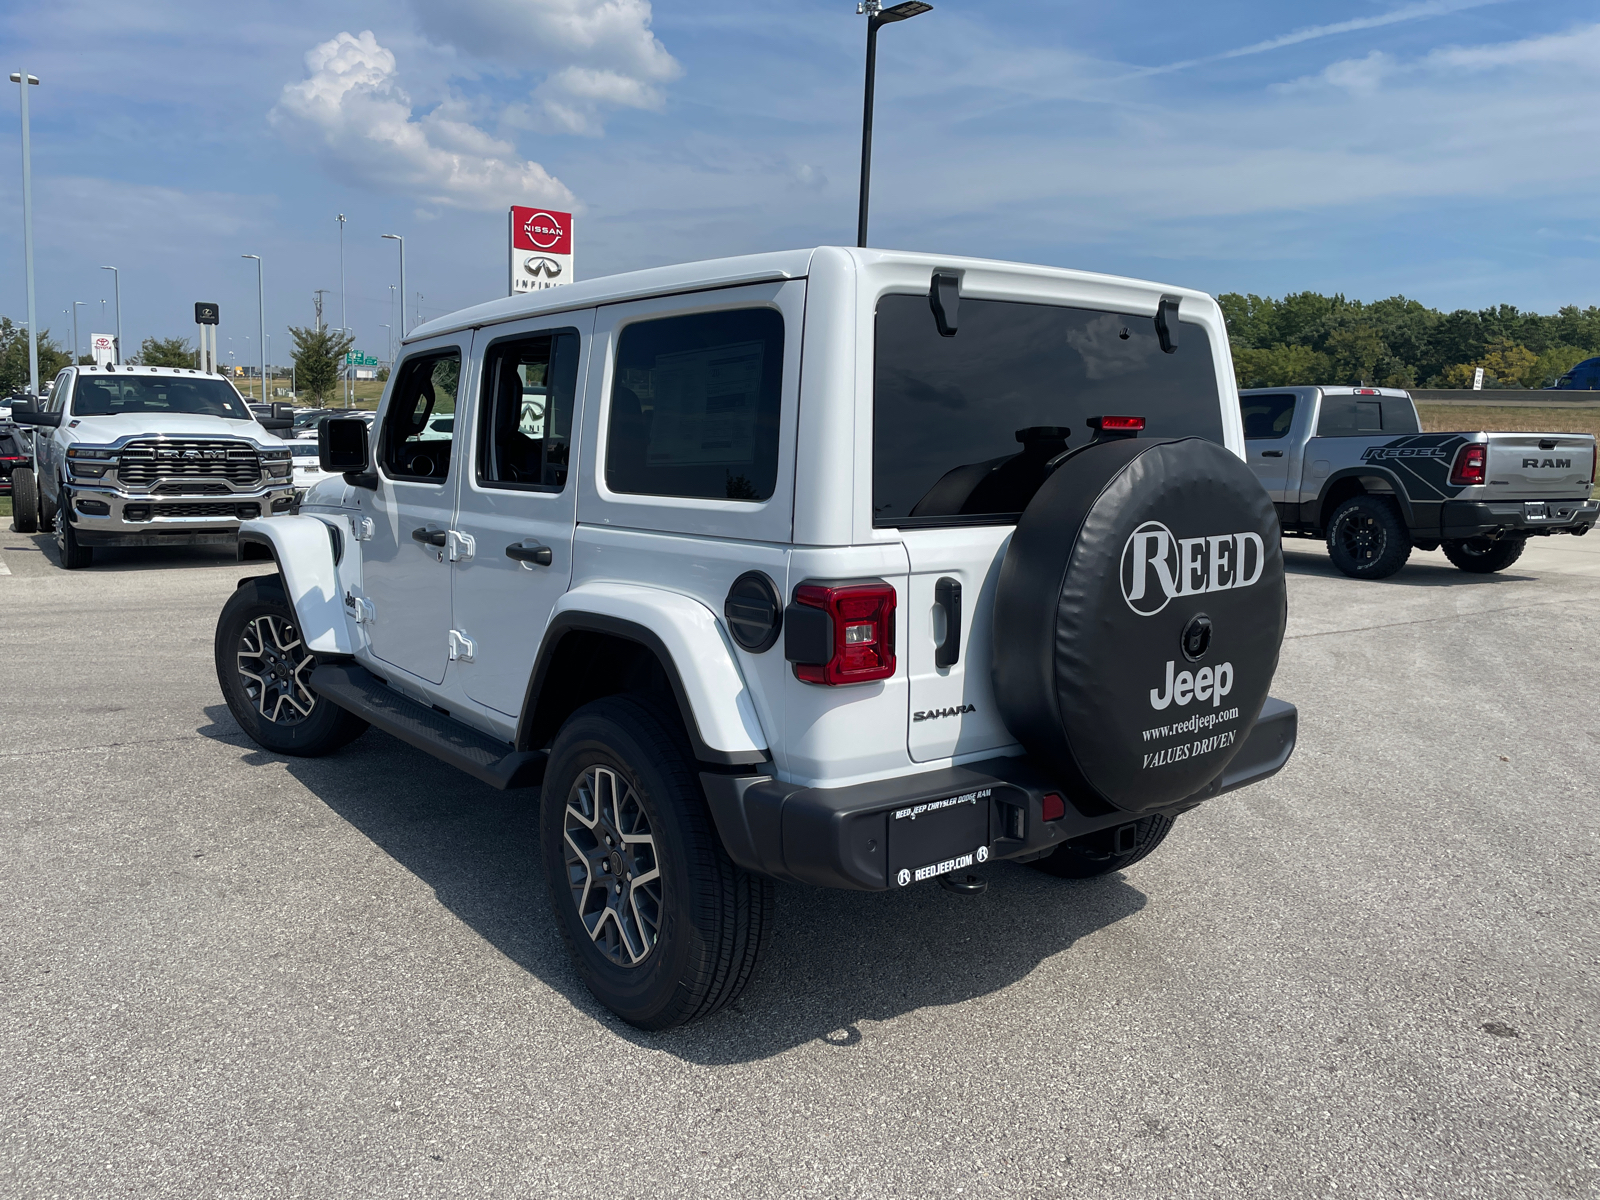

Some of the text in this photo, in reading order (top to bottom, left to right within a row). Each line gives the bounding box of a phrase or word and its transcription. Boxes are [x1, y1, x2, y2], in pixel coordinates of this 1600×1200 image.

[524, 225, 563, 236] NISSAN
[516, 279, 564, 290] INFIN
[157, 450, 226, 460] RAM
[1360, 446, 1448, 460] REBEL
[1522, 458, 1571, 468] RAM
[1127, 531, 1265, 600] REED
[1150, 660, 1234, 711] Jeep
[913, 704, 976, 722] SAHARA
[1142, 707, 1239, 742] www.reedjeep.com
[1142, 730, 1237, 769] VALUES DRIVEN
[895, 788, 992, 820] REED JEEP CHRYSLER DODGE RAM
[914, 854, 973, 882] REEDJEEP.COM
